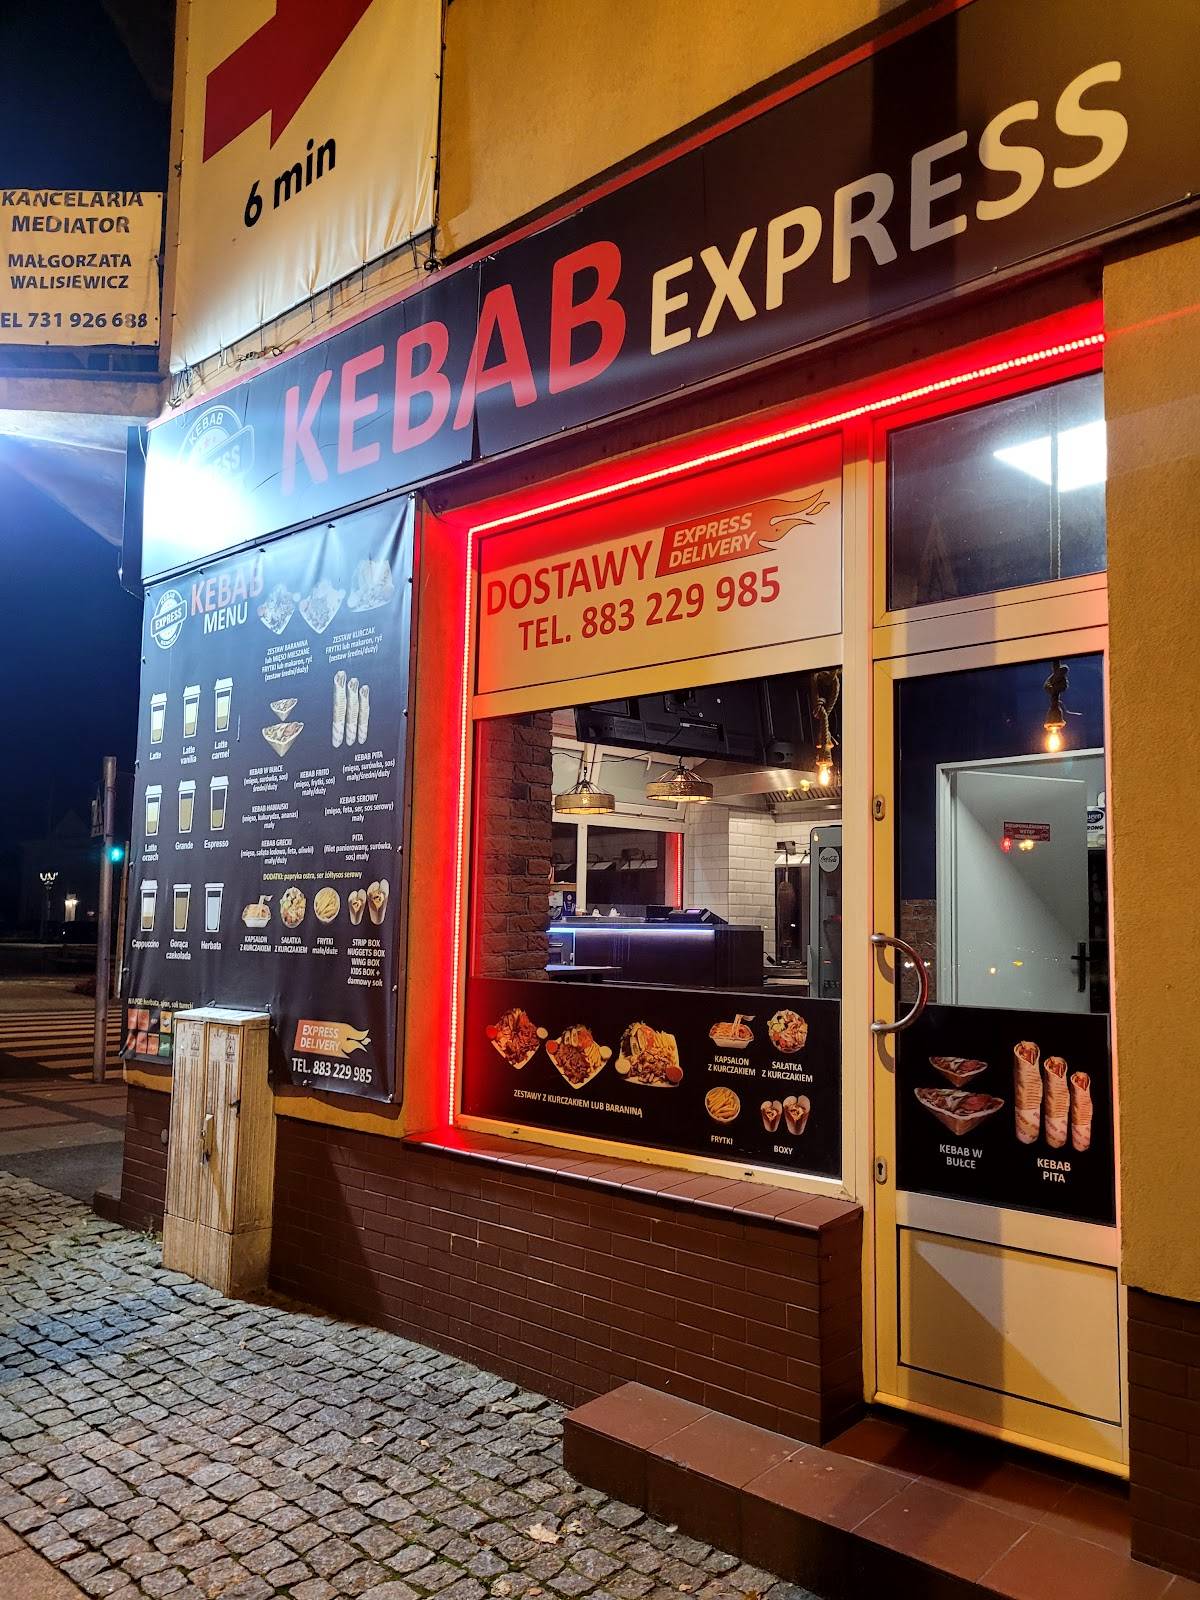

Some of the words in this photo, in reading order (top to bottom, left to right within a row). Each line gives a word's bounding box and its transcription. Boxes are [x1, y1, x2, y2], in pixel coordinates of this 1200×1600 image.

[244, 180, 262, 228] 6
[274, 138, 336, 210] min
[1, 191, 144, 208] KANCELARIA
[650, 61, 1129, 356] EXPRESS
[12, 215, 130, 234] MEDIATOR
[8, 253, 132, 268] MAŁGORZATA
[10, 275, 129, 289] WALISIEWICZ
[0, 312, 22, 328] EL
[28, 312, 62, 328] 731
[70, 312, 107, 328] 926
[282, 240, 626, 496] KEBAB
[189, 412, 224, 445] KEBAB
[672, 512, 752, 546] EXPRESS
[669, 531, 758, 568] DELIVERY
[487, 540, 654, 616] DOSTAWY
[190, 558, 264, 616] KEBAB
[518, 615, 572, 651] TEL.
[582, 598, 635, 639] 883
[646, 583, 705, 626] 229
[716, 566, 780, 612] 985
[155, 607, 182, 631] EXPRESS
[204, 601, 248, 634] MENU
[325, 643, 342, 654] FRYTKI
[214, 740, 228, 750] Latte
[175, 841, 194, 850] Grande
[204, 839, 229, 850] Espresso
[142, 851, 159, 862] orzech
[132, 939, 160, 949] Cappuccino
[169, 939, 189, 950] Gorąca
[200, 940, 222, 951] Herbata
[317, 937, 334, 946] FRYTKI
[352, 938, 367, 947] STRIP
[367, 938, 381, 947] BOX
[166, 951, 192, 961] czekolada
[347, 948, 373, 957] NUGGETS
[373, 949, 386, 958] BOX
[351, 958, 366, 966] WING
[367, 958, 380, 967] BOX
[350, 968, 362, 976] KIDS
[362, 968, 375, 977] BOX
[302, 1024, 340, 1039] EXPRESS
[300, 1038, 341, 1052] DELIVERY
[714, 1055, 750, 1066] KAPSALON
[772, 1061, 803, 1072] SAŁATKA
[292, 1058, 311, 1074] TEL.
[313, 1060, 332, 1077] 883
[333, 1063, 352, 1080] 229
[353, 1067, 373, 1084] 985
[713, 1064, 756, 1076] KURCZAKIEM
[762, 1069, 767, 1078] Z
[768, 1070, 813, 1083] KURCZAKIEM
[514, 1089, 542, 1102] ZESTAWY
[542, 1092, 547, 1102] Z
[548, 1094, 590, 1109] KURCZAKIEM
[591, 1100, 604, 1110] LUB
[605, 1102, 643, 1118] BARANINĄ
[711, 1135, 733, 1145] FRYTKI
[774, 1145, 793, 1155] BOXY
[939, 1144, 970, 1157] KEBAB
[972, 1148, 983, 1158] W
[946, 1157, 976, 1169] BUŁCE
[1037, 1158, 1072, 1172] KEBAB
[1043, 1171, 1066, 1183] PITA
